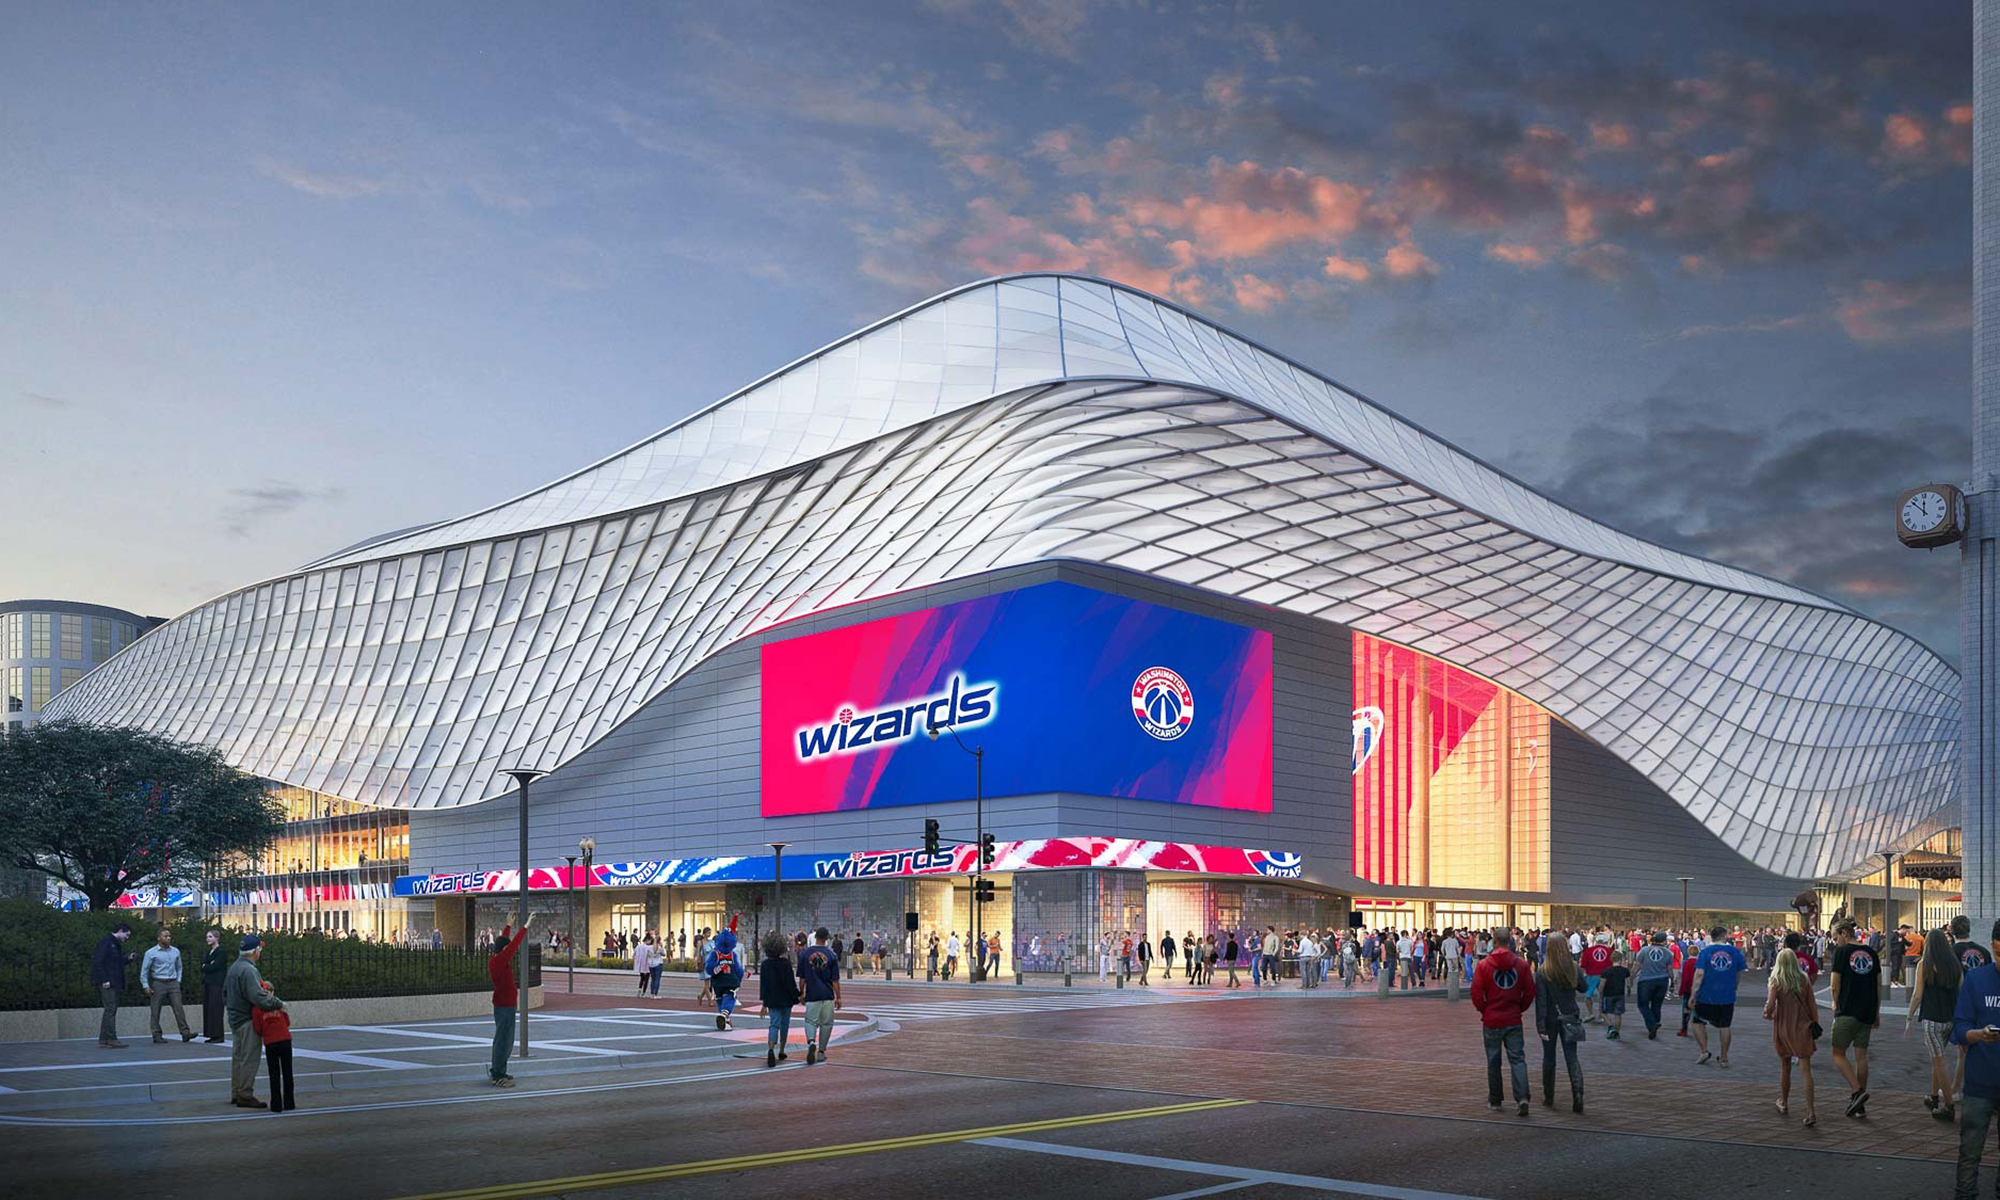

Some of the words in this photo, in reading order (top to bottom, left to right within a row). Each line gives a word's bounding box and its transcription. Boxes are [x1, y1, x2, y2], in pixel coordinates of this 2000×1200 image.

[1139, 669, 1186, 693] WASHINGTON
[799, 675, 996, 758] wizards
[1145, 720, 1182, 737] WIZARDS
[413, 872, 486, 894] wizards
[610, 861, 657, 886] WIZARDS
